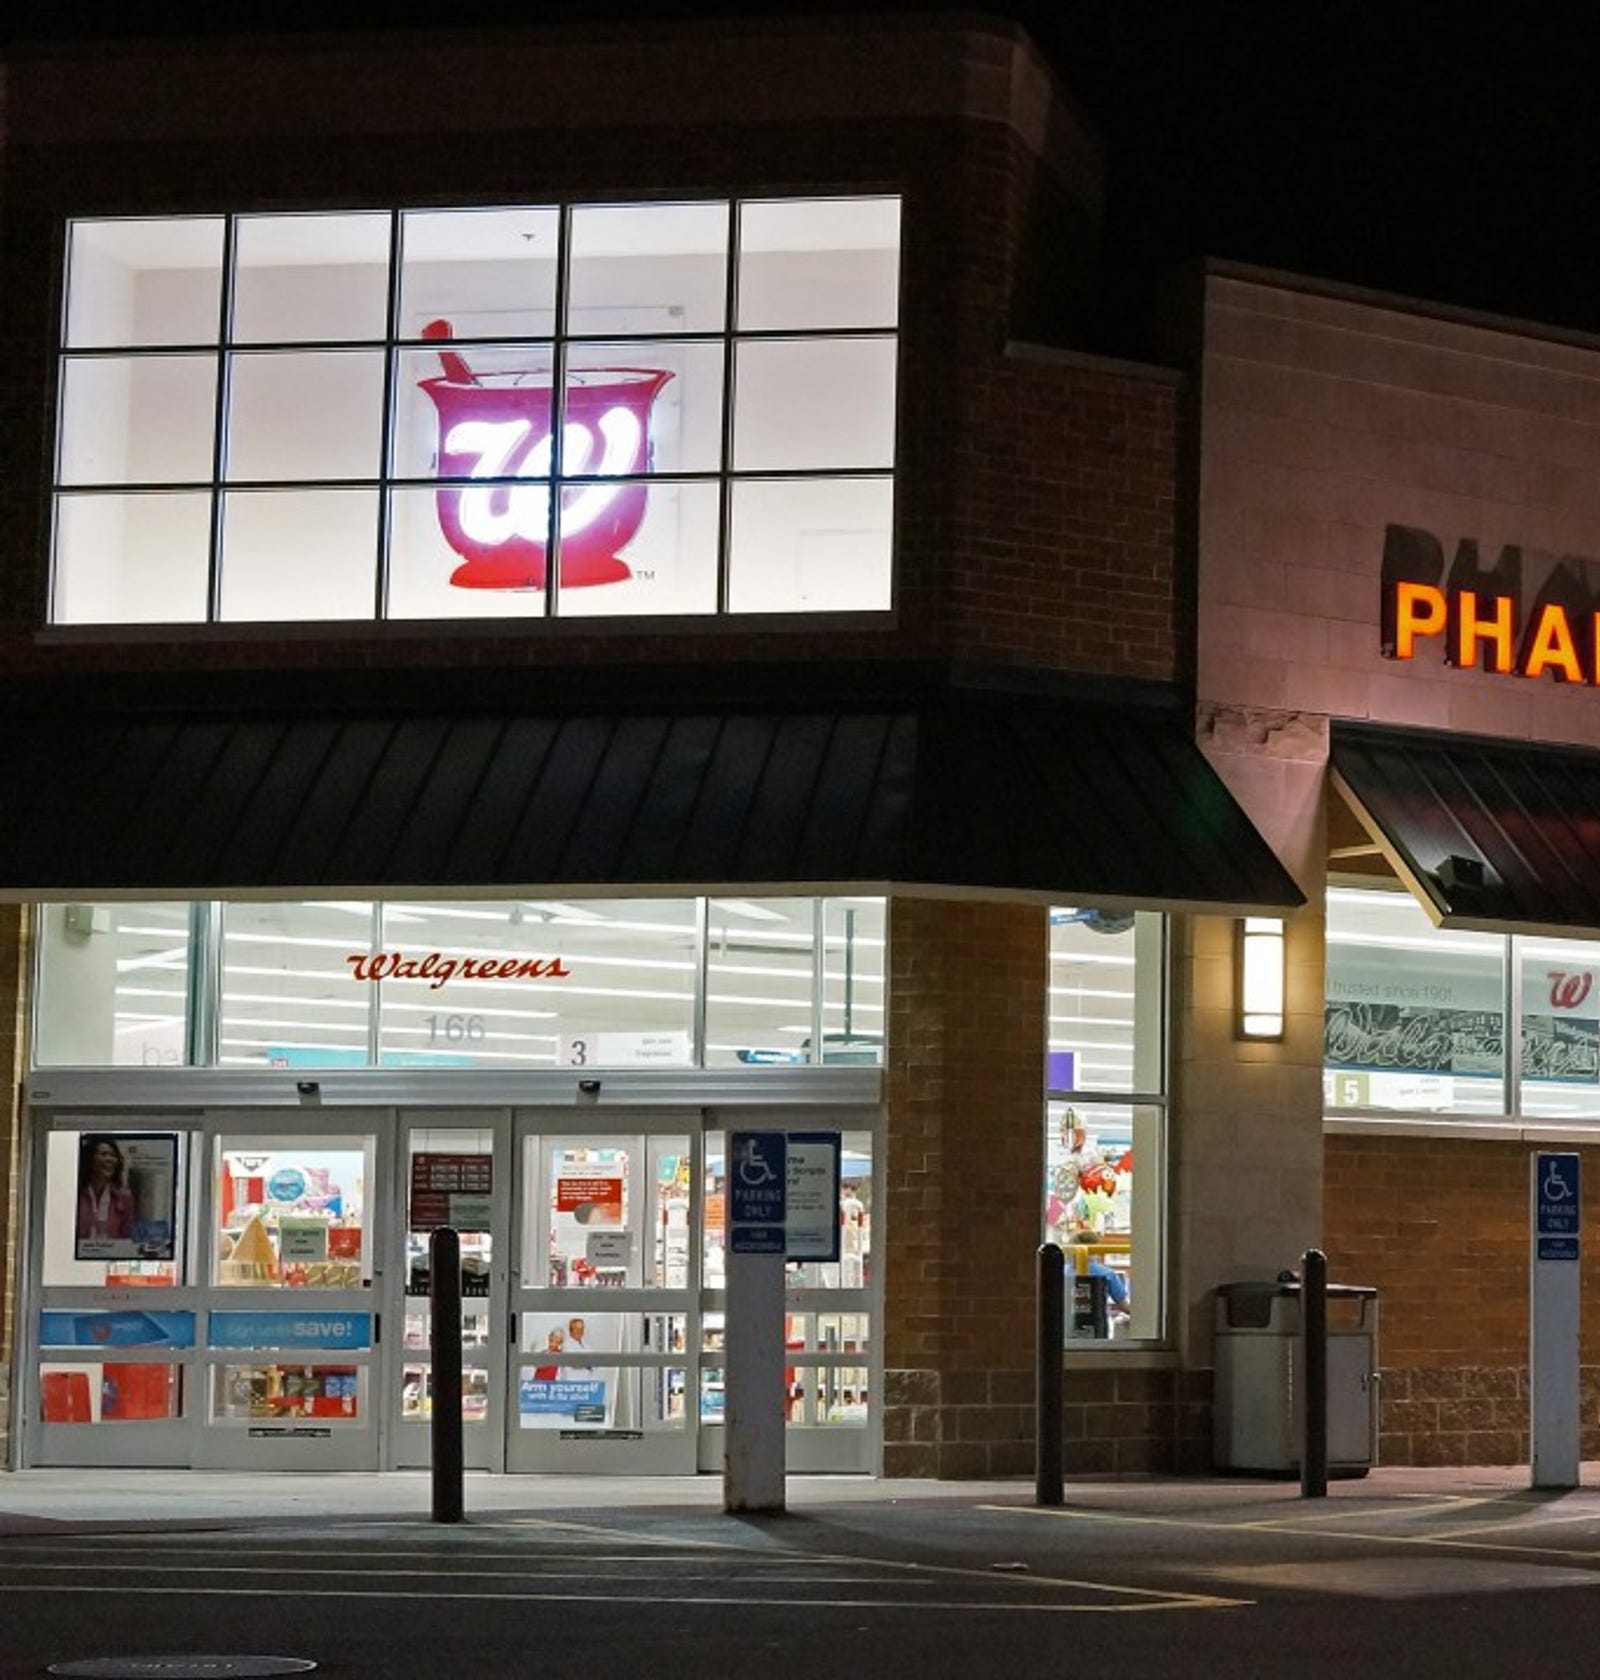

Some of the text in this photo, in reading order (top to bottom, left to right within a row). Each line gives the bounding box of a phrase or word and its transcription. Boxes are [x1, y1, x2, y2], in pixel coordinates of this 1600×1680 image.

[346, 953, 571, 990] Walgreens
[422, 1013, 488, 1045] 166
[570, 1041, 588, 1066] 3
[1343, 1080, 1360, 1105] 5
[734, 1189, 782, 1202] PARKING
[293, 1320, 352, 1337] save!
[521, 1382, 599, 1395] Arm yourself
